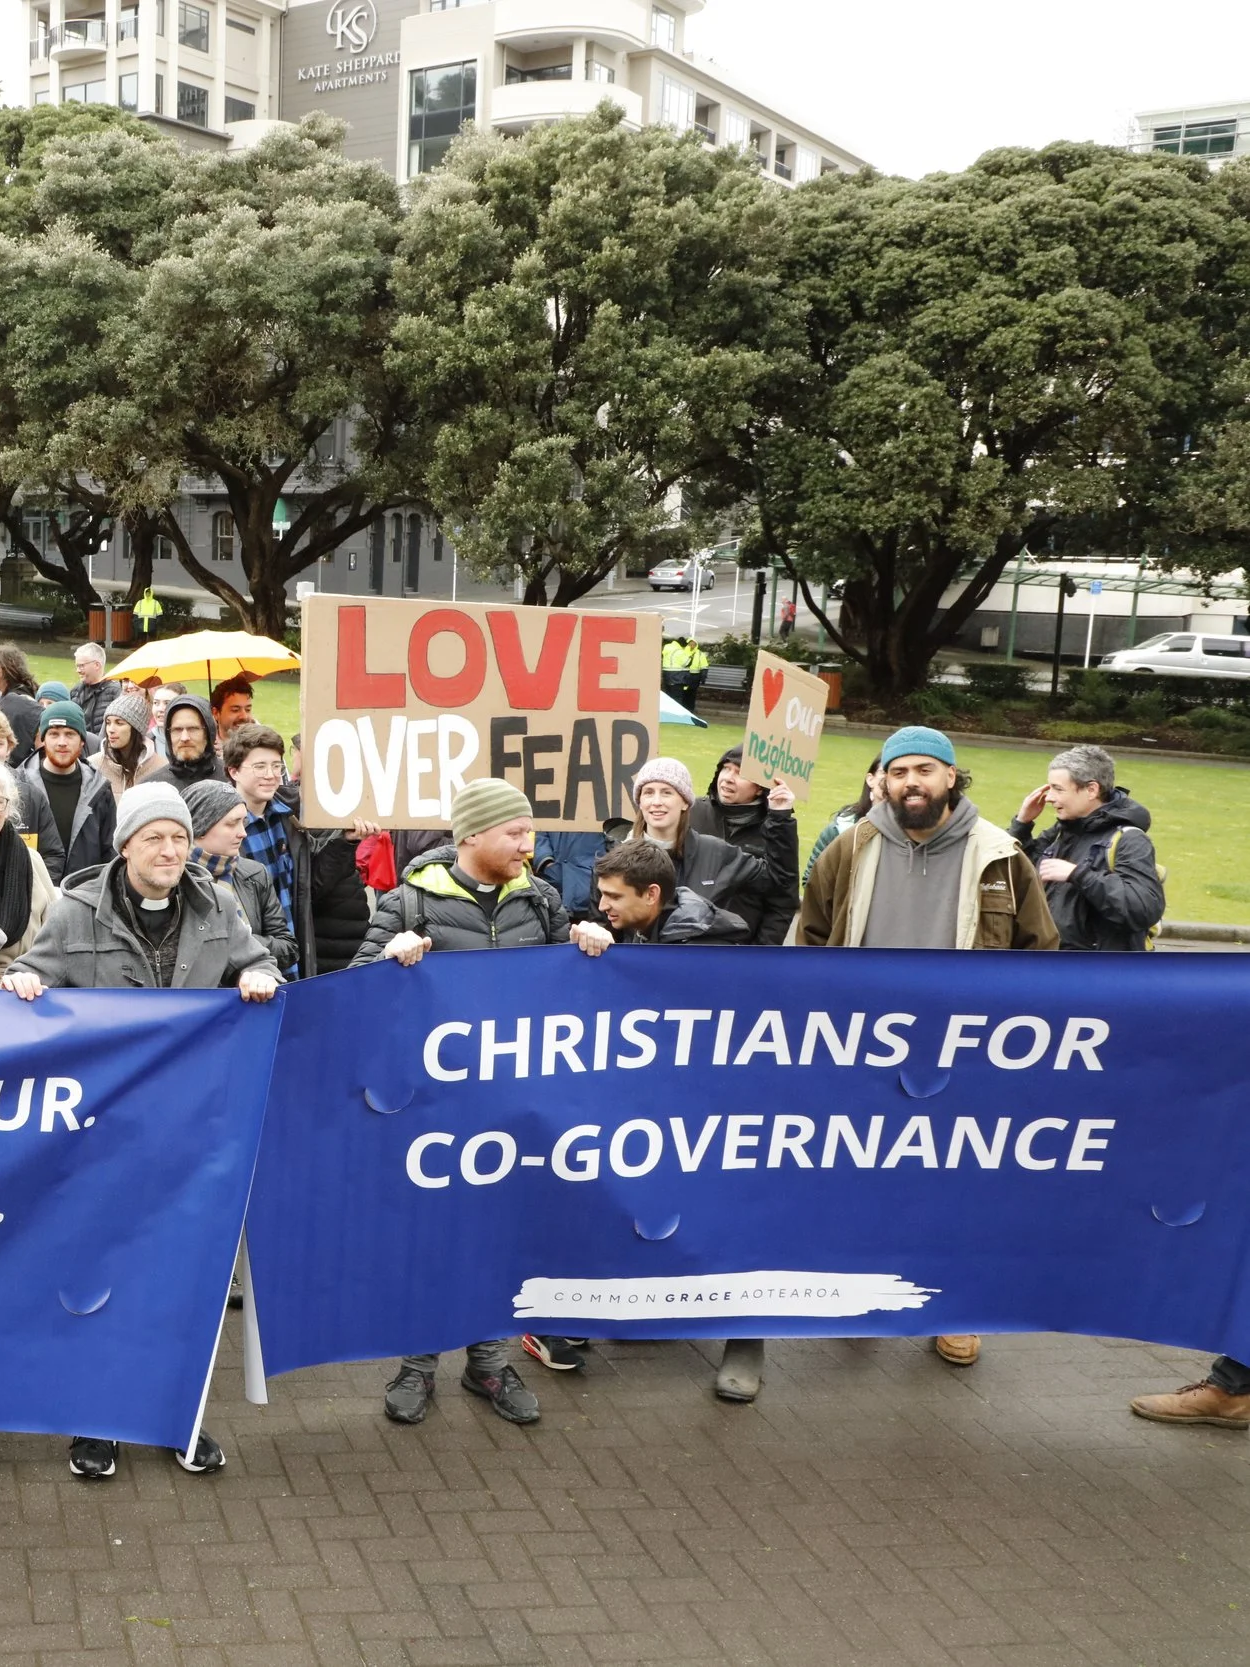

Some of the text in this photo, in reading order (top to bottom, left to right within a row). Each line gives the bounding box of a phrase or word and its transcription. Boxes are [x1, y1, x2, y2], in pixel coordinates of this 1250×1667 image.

[334, 5, 368, 54] KS
[298, 64, 330, 81] KATE
[313, 70, 387, 92] APARTMENTS
[336, 605, 640, 713] LOVE
[313, 714, 650, 822] OVER FEAR
[748, 732, 814, 783] neighbour
[422, 1009, 1111, 1082] CHRISTIANS FOR
[405, 1114, 1117, 1189] CO-GOVERNANCE
[553, 1287, 841, 1304] COMMON GRACE AOTEAROA
